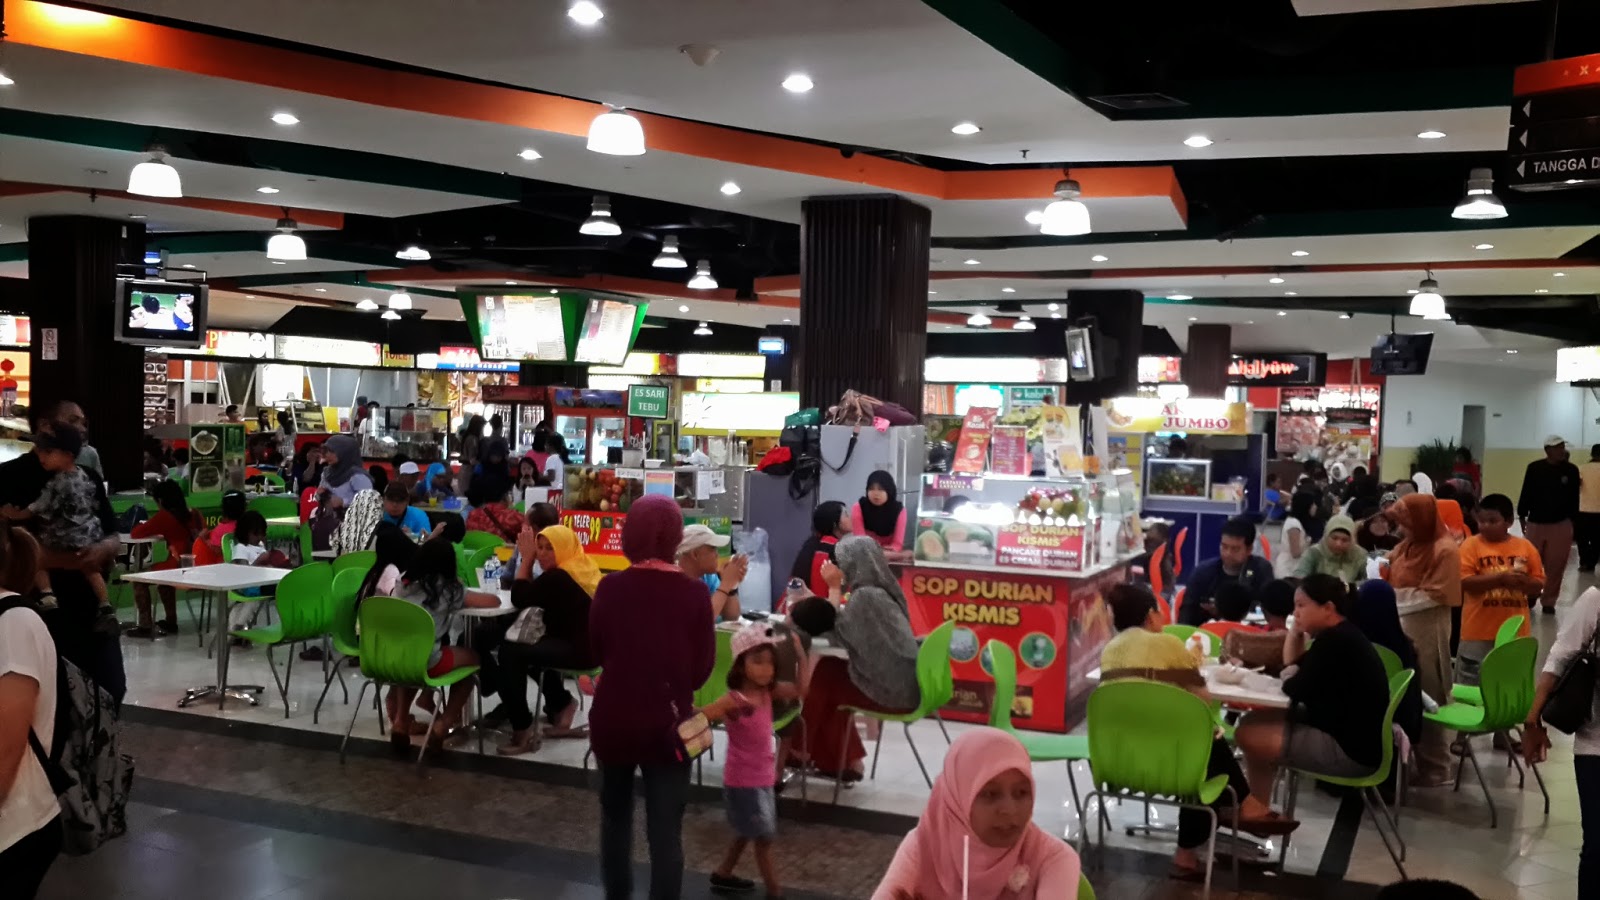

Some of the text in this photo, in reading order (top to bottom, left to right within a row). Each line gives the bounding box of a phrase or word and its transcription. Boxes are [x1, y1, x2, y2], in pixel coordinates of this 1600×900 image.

[1533, 156, 1600, 173] TANGGA D
[635, 389, 665, 398] ES SARI
[638, 402, 659, 412] TEBU
[1163, 417, 1229, 429] JUMBO
[574, 514, 590, 528] TELER
[1001, 523, 1079, 536] SOP DURIAN
[1017, 536, 1061, 547] KISMIS
[1001, 546, 1078, 559] PANCAKE DURIAN
[1043, 558, 1078, 568] DURIAN
[1479, 555, 1505, 567] IT'S
[913, 576, 1054, 603] SOP DURIAN
[942, 602, 1021, 626] KISMIS
